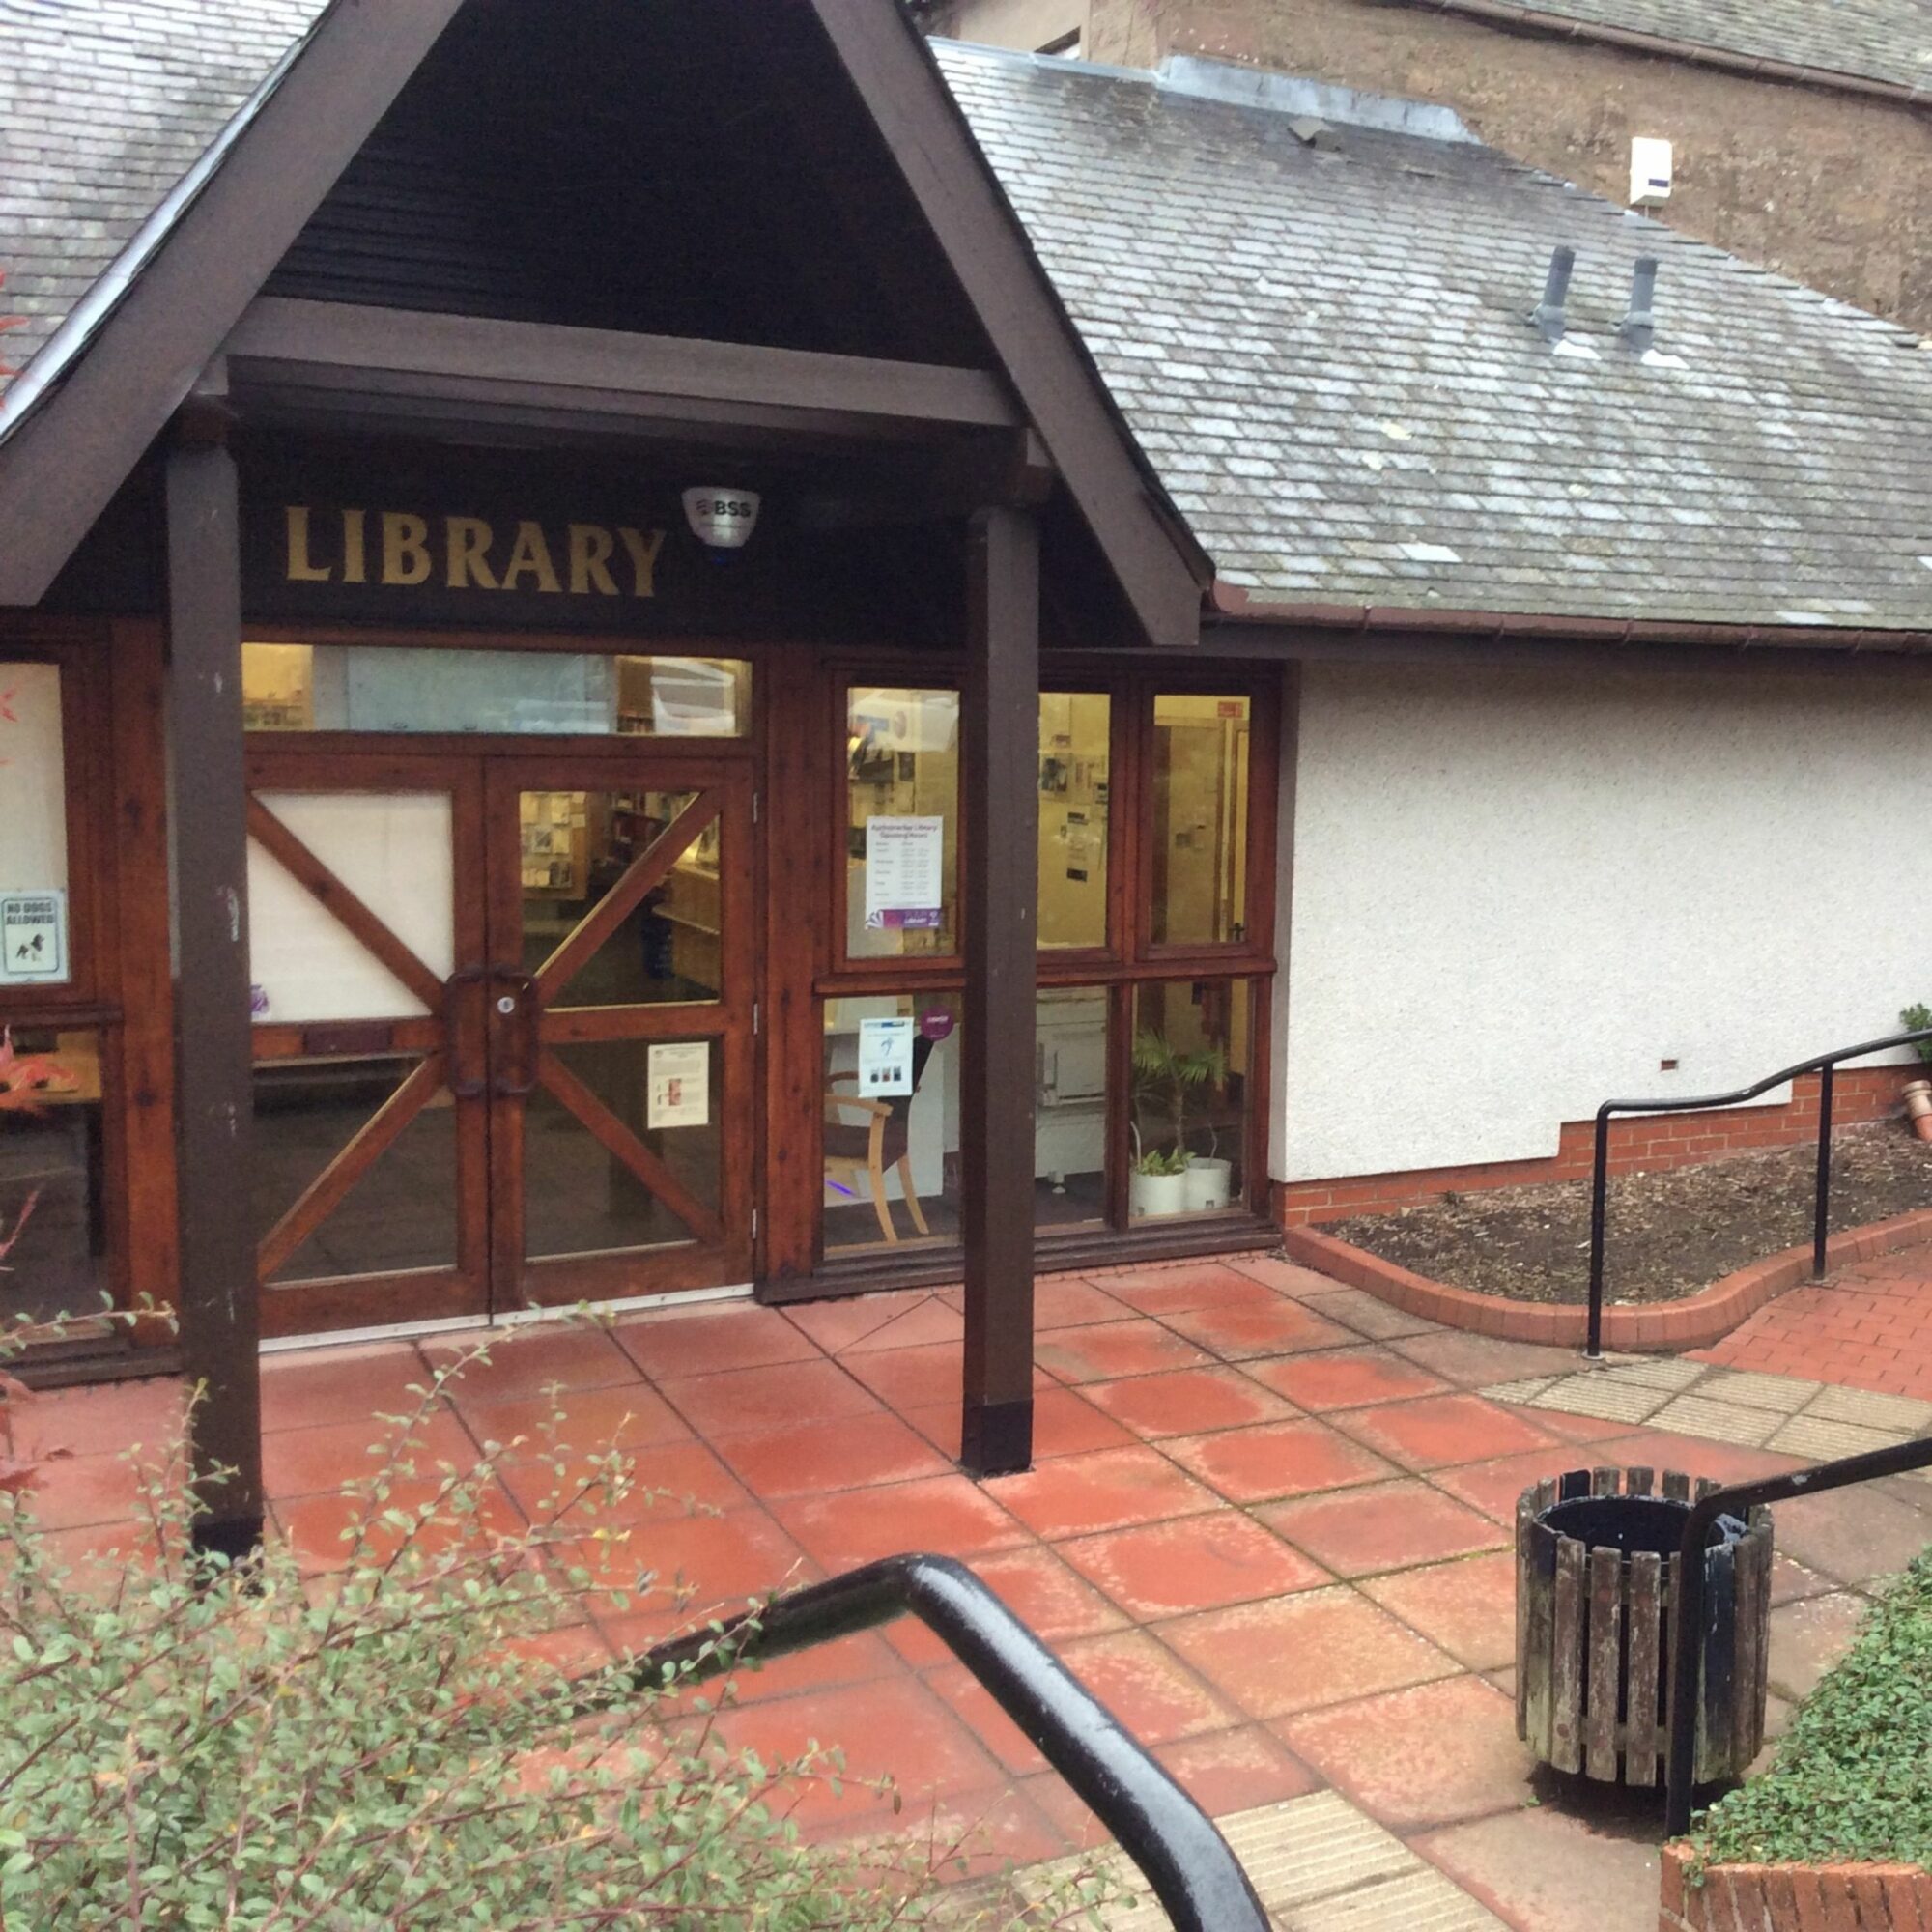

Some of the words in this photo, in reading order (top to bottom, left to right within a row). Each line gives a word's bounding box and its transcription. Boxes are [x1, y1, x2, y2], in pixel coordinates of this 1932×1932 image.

[714, 500, 751, 518] BSS
[285, 505, 667, 598] LIBRARY
[7, 903, 21, 914] NO
[23, 902, 52, 913] DOGS
[6, 914, 54, 924] ALLOWED
